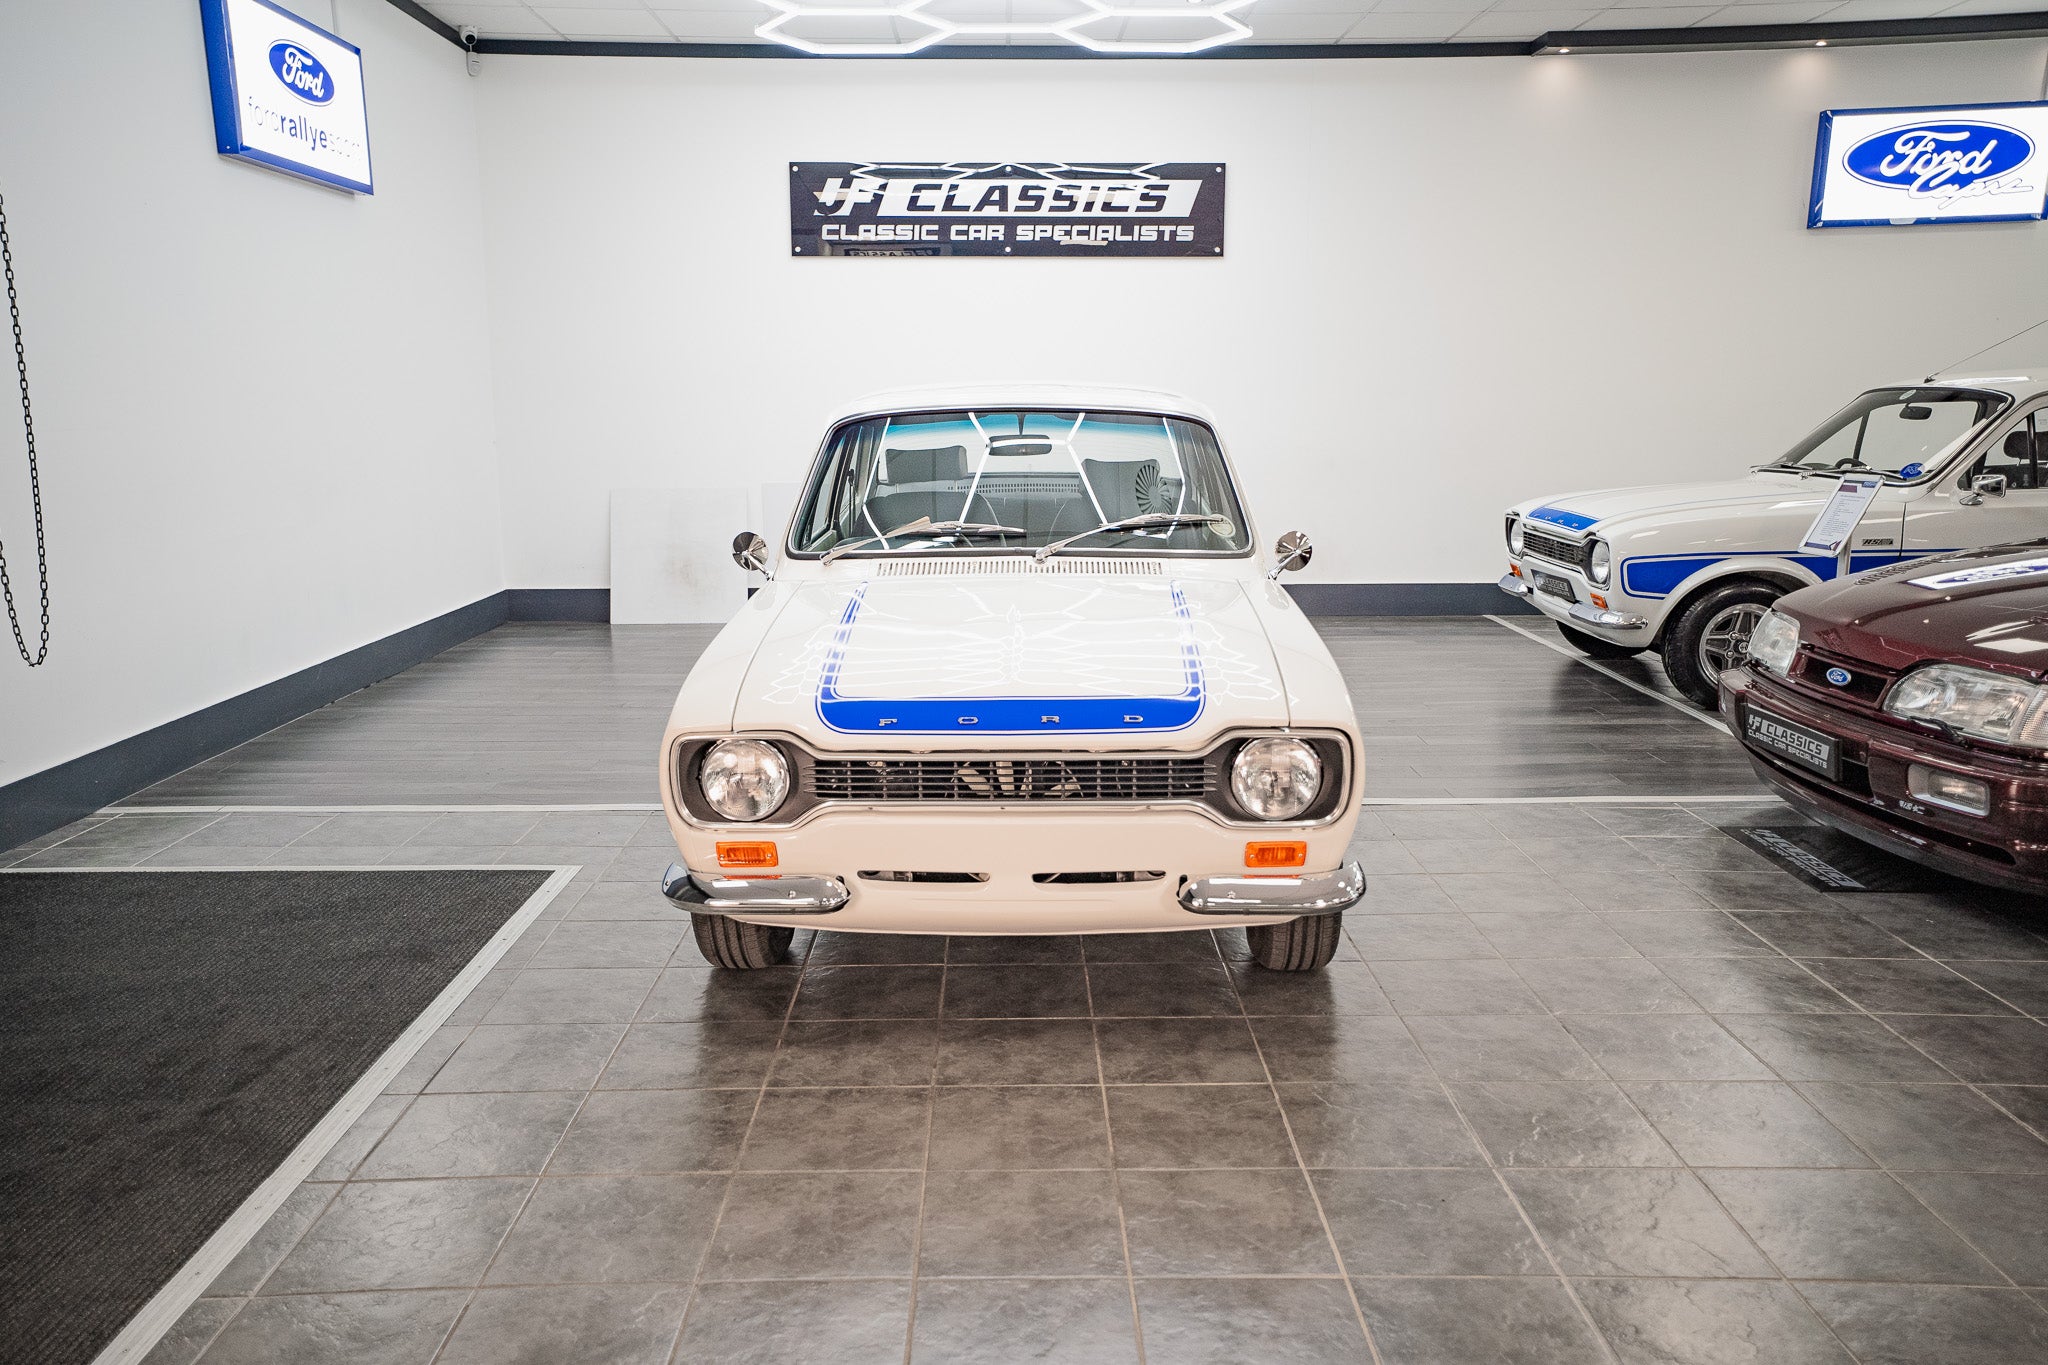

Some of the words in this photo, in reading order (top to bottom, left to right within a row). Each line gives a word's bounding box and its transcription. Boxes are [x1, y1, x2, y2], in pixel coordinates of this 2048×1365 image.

[282, 47, 325, 98] Ford
[1879, 130, 1998, 177] Ford
[906, 183, 1170, 213] CLASSICS
[822, 224, 939, 241] CLASSIC
[950, 224, 1005, 241] CAR
[1016, 224, 1195, 242] SPECIALISTS
[1830, 670, 1845, 682] Ford
[1747, 729, 1773, 745] CLASSIC
[1773, 740, 1787, 752] CAR
[1787, 745, 1828, 769] SPECIALISTS
[1766, 723, 1822, 756] CLASSICS
